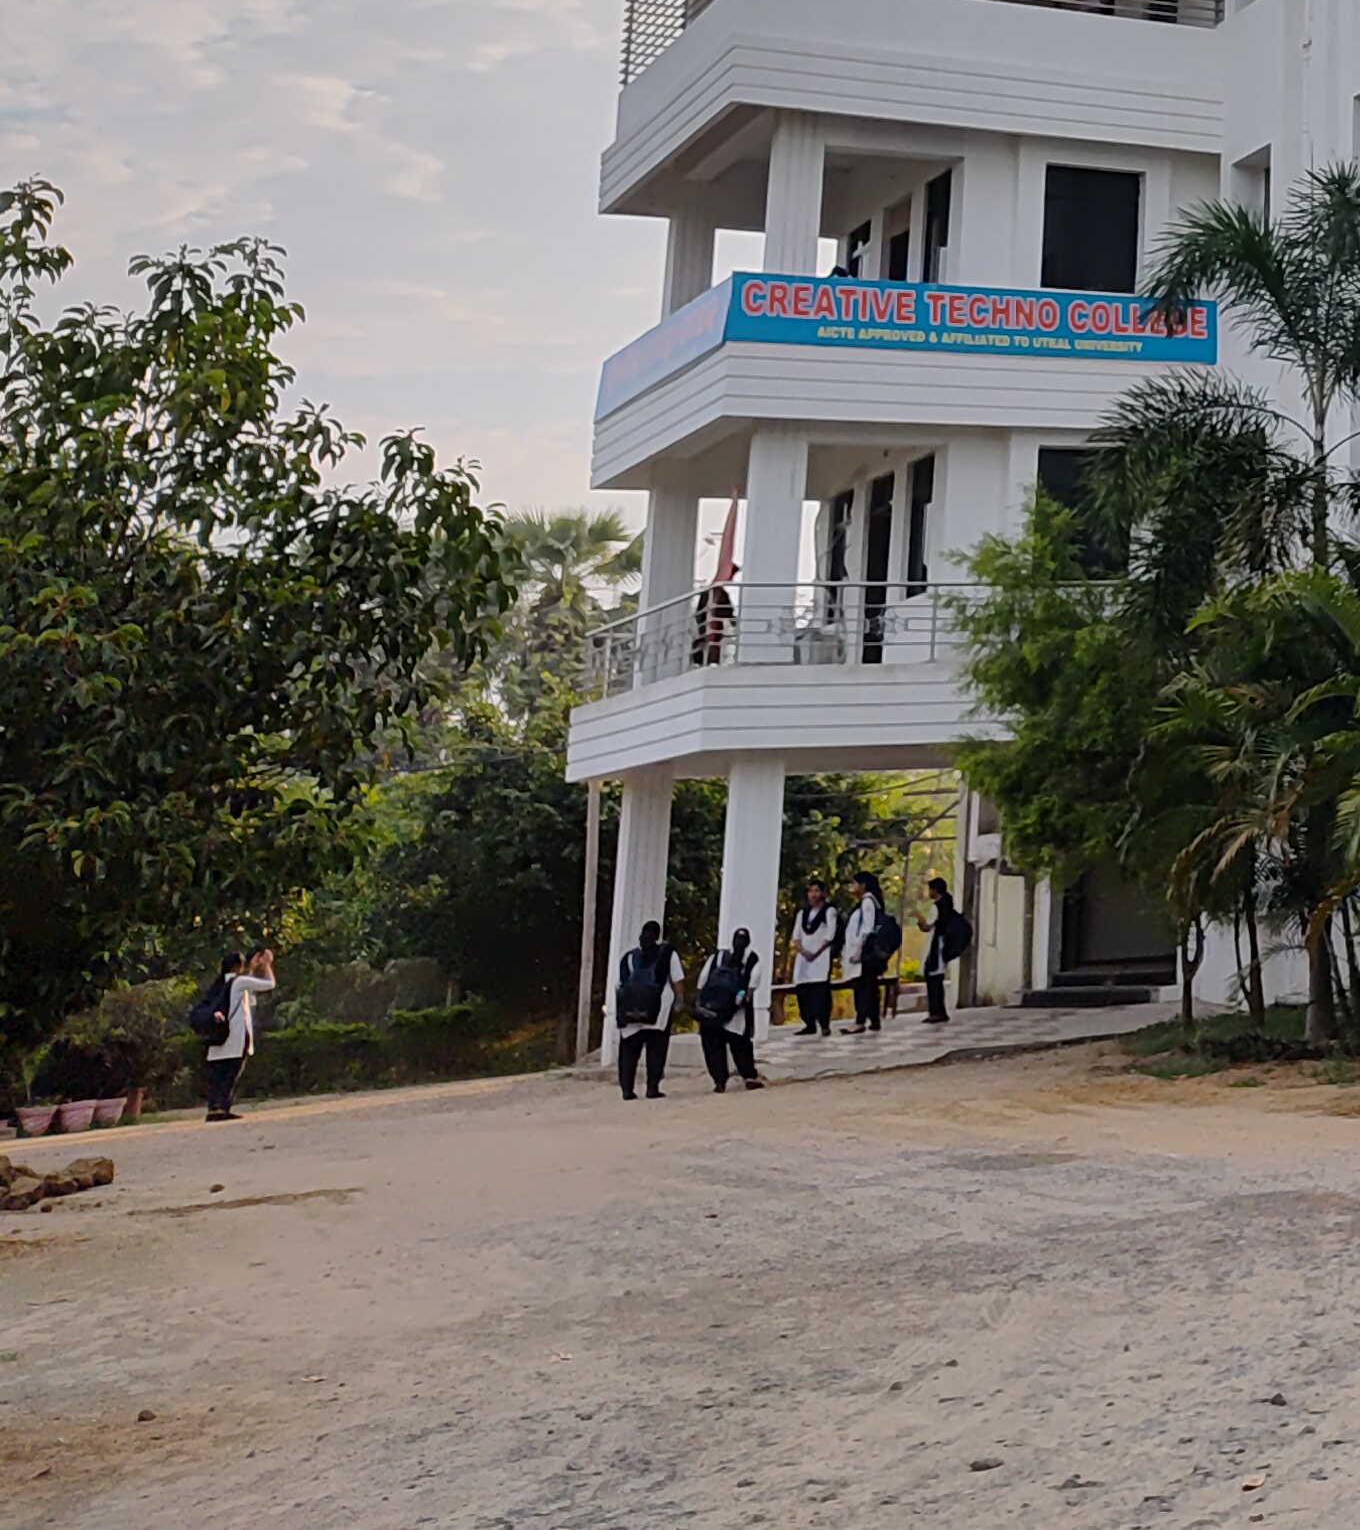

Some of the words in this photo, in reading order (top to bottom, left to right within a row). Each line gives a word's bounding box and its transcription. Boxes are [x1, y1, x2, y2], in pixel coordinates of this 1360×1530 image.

[742, 280, 916, 325] CREATIVE
[924, 291, 1060, 331] TECHNO
[817, 326, 855, 339] AICTE
[858, 328, 926, 342] APPROVED
[1013, 335, 1030, 348] TO
